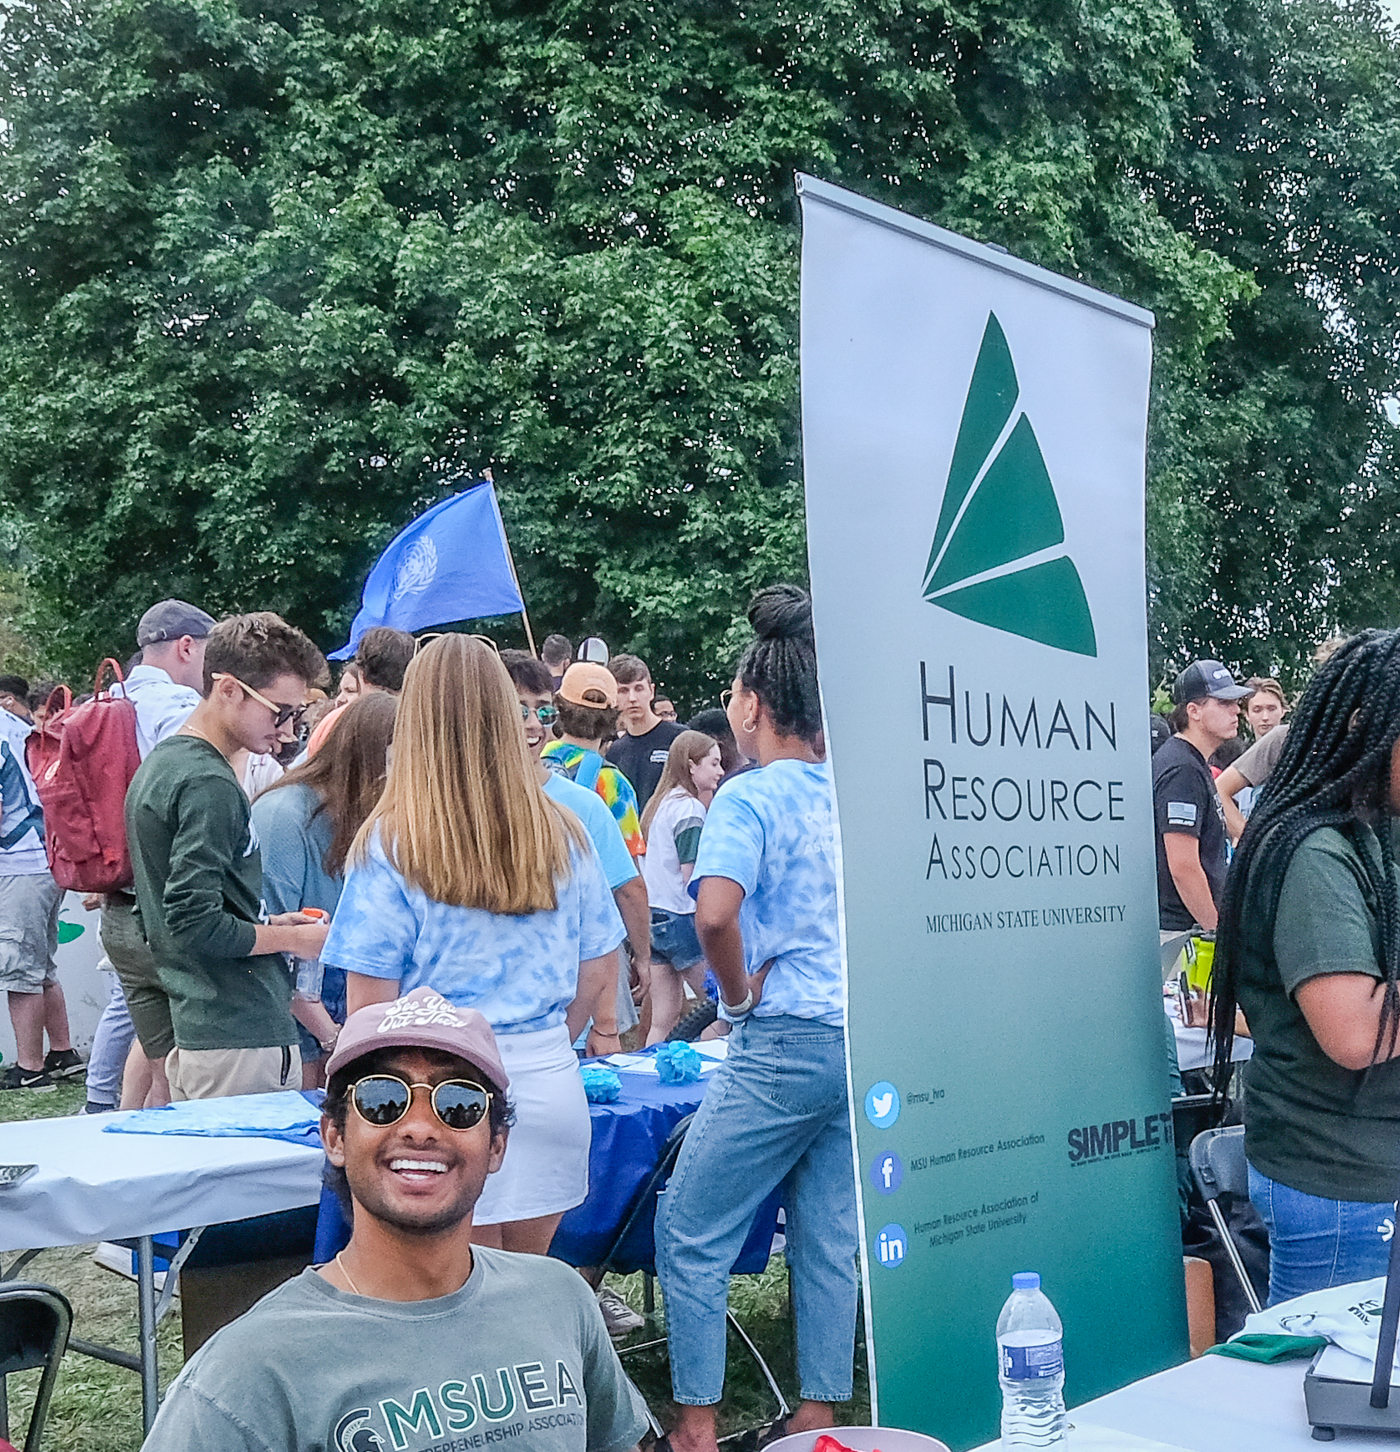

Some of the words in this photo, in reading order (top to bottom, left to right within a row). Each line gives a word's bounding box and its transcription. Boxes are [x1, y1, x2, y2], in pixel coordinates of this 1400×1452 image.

[920, 661, 1117, 751] HUMAN
[924, 758, 1125, 822] RESOURCE
[926, 833, 1120, 880] ASSOCIATION
[926, 913, 993, 934] MICHIGAN
[997, 910, 1039, 928] STATE
[1043, 905, 1126, 926] UNIVERSITY
[385, 996, 419, 1015] See
[423, 996, 458, 1014] You
[910, 1159, 928, 1172] MSU
[929, 1153, 956, 1168] Human
[958, 1144, 994, 1160] Resource
[997, 1133, 1045, 1152] Association
[914, 1218, 941, 1234] Human
[943, 1207, 978, 1224] Resource
[981, 1196, 1028, 1215] Association
[929, 1228, 964, 1248] Michigan
[965, 1221, 986, 1236] State
[988, 1212, 1027, 1232] University
[380, 1359, 584, 1452] MSUEA
